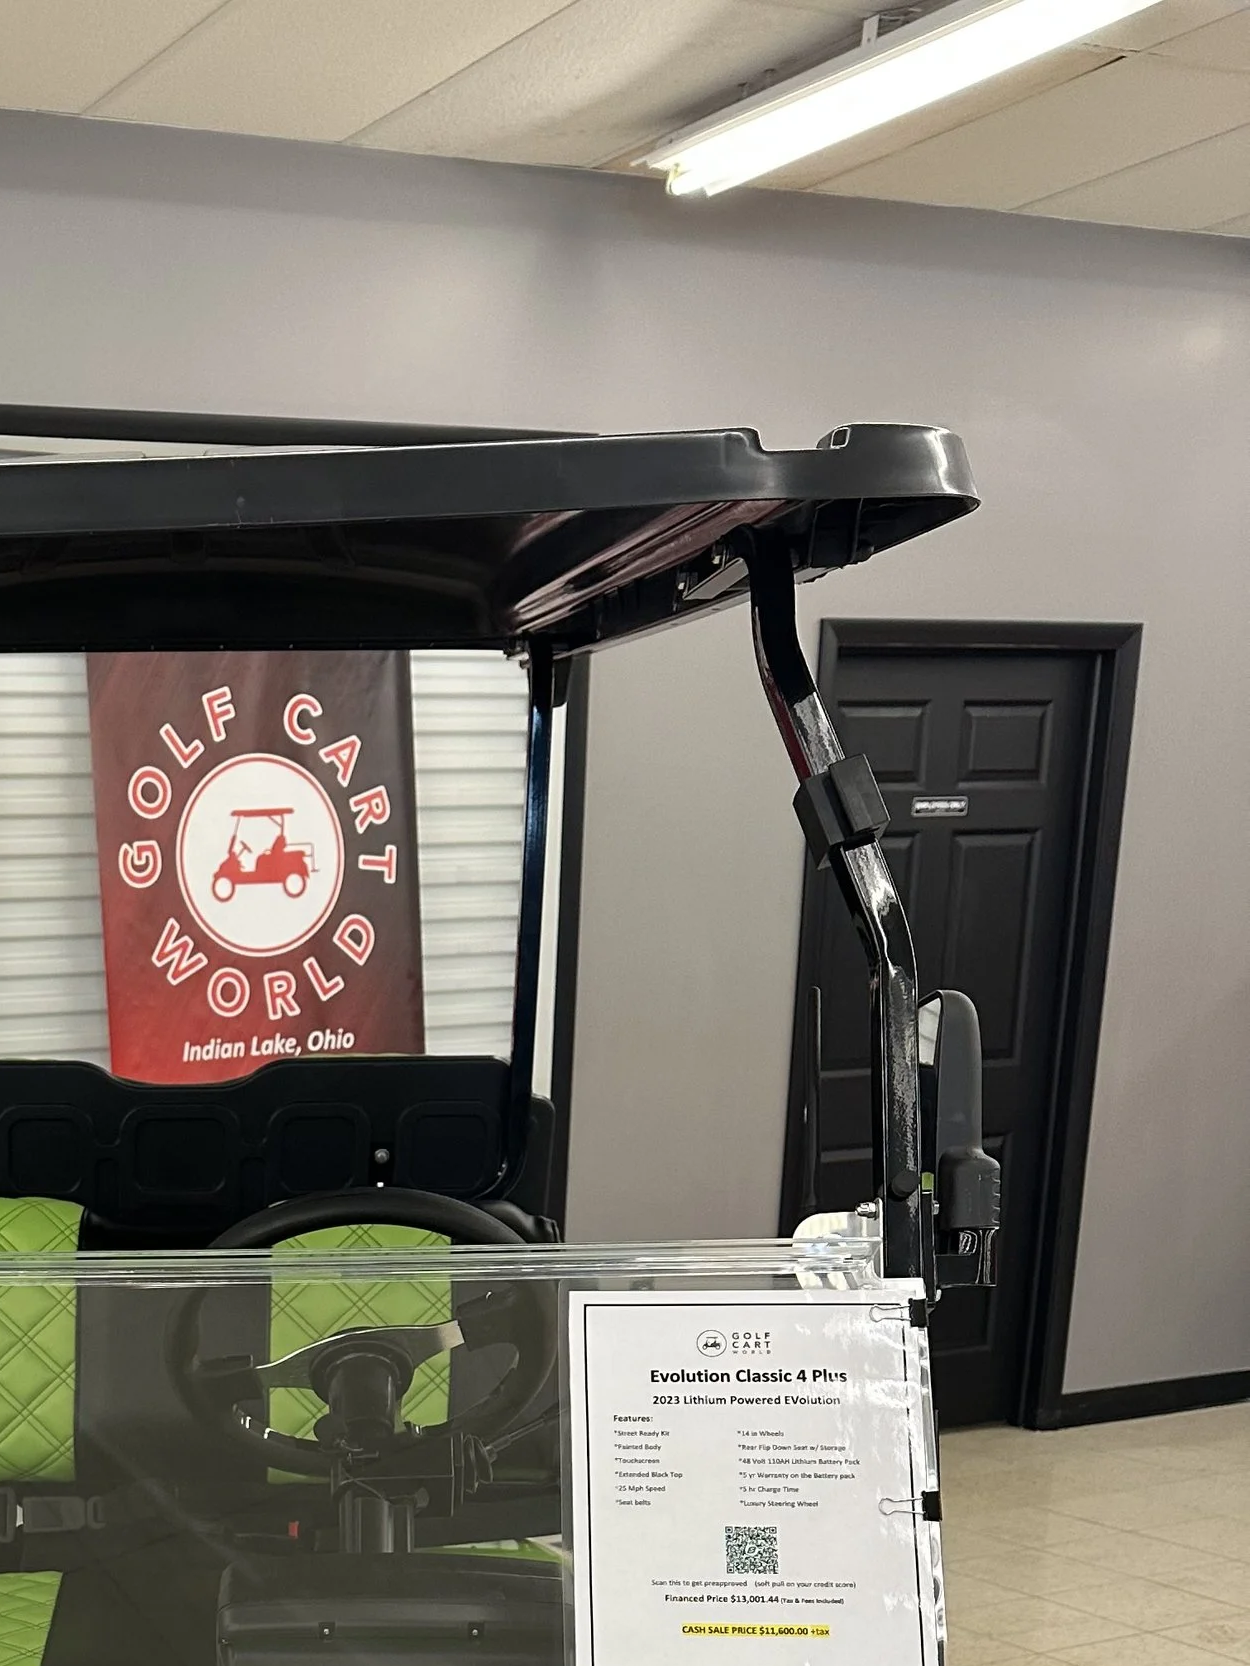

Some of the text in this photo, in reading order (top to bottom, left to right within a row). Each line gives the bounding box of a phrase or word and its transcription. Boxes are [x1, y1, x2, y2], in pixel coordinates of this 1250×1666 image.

[118, 686, 237, 889] GOLF
[284, 693, 397, 885] CART
[151, 913, 376, 1020] WORLD
[183, 1028, 355, 1063] Indian Lake, Ohio
[732, 1332, 770, 1340] GOLF
[732, 1341, 771, 1349] CART
[650, 1369, 847, 1383] Evolution Classic 4 Plus
[652, 1395, 841, 1405] 2023 Lithium Powered EVolution
[613, 1414, 654, 1423] Features:
[639, 1430, 659, 1438] Ready
[818, 1458, 843, 1466] Battery
[757, 1472, 789, 1480] Warranty
[813, 1472, 838, 1480] Battery
[628, 1485, 644, 1493] Mph
[645, 1485, 666, 1493] Speed
[757, 1486, 781, 1494] Charge
[767, 1500, 796, 1508] Steering
[691, 1580, 703, 1588] get
[703, 1580, 748, 1588] preapproved
[754, 1580, 771, 1588] (soft
[771, 1580, 785, 1588] pull
[664, 1594, 705, 1602] Financed
[706, 1594, 728, 1603] Price
[730, 1594, 779, 1604] $13,001.44
[682, 1626, 830, 1636] CASH SALE PRICE $11,600.00 +tax
